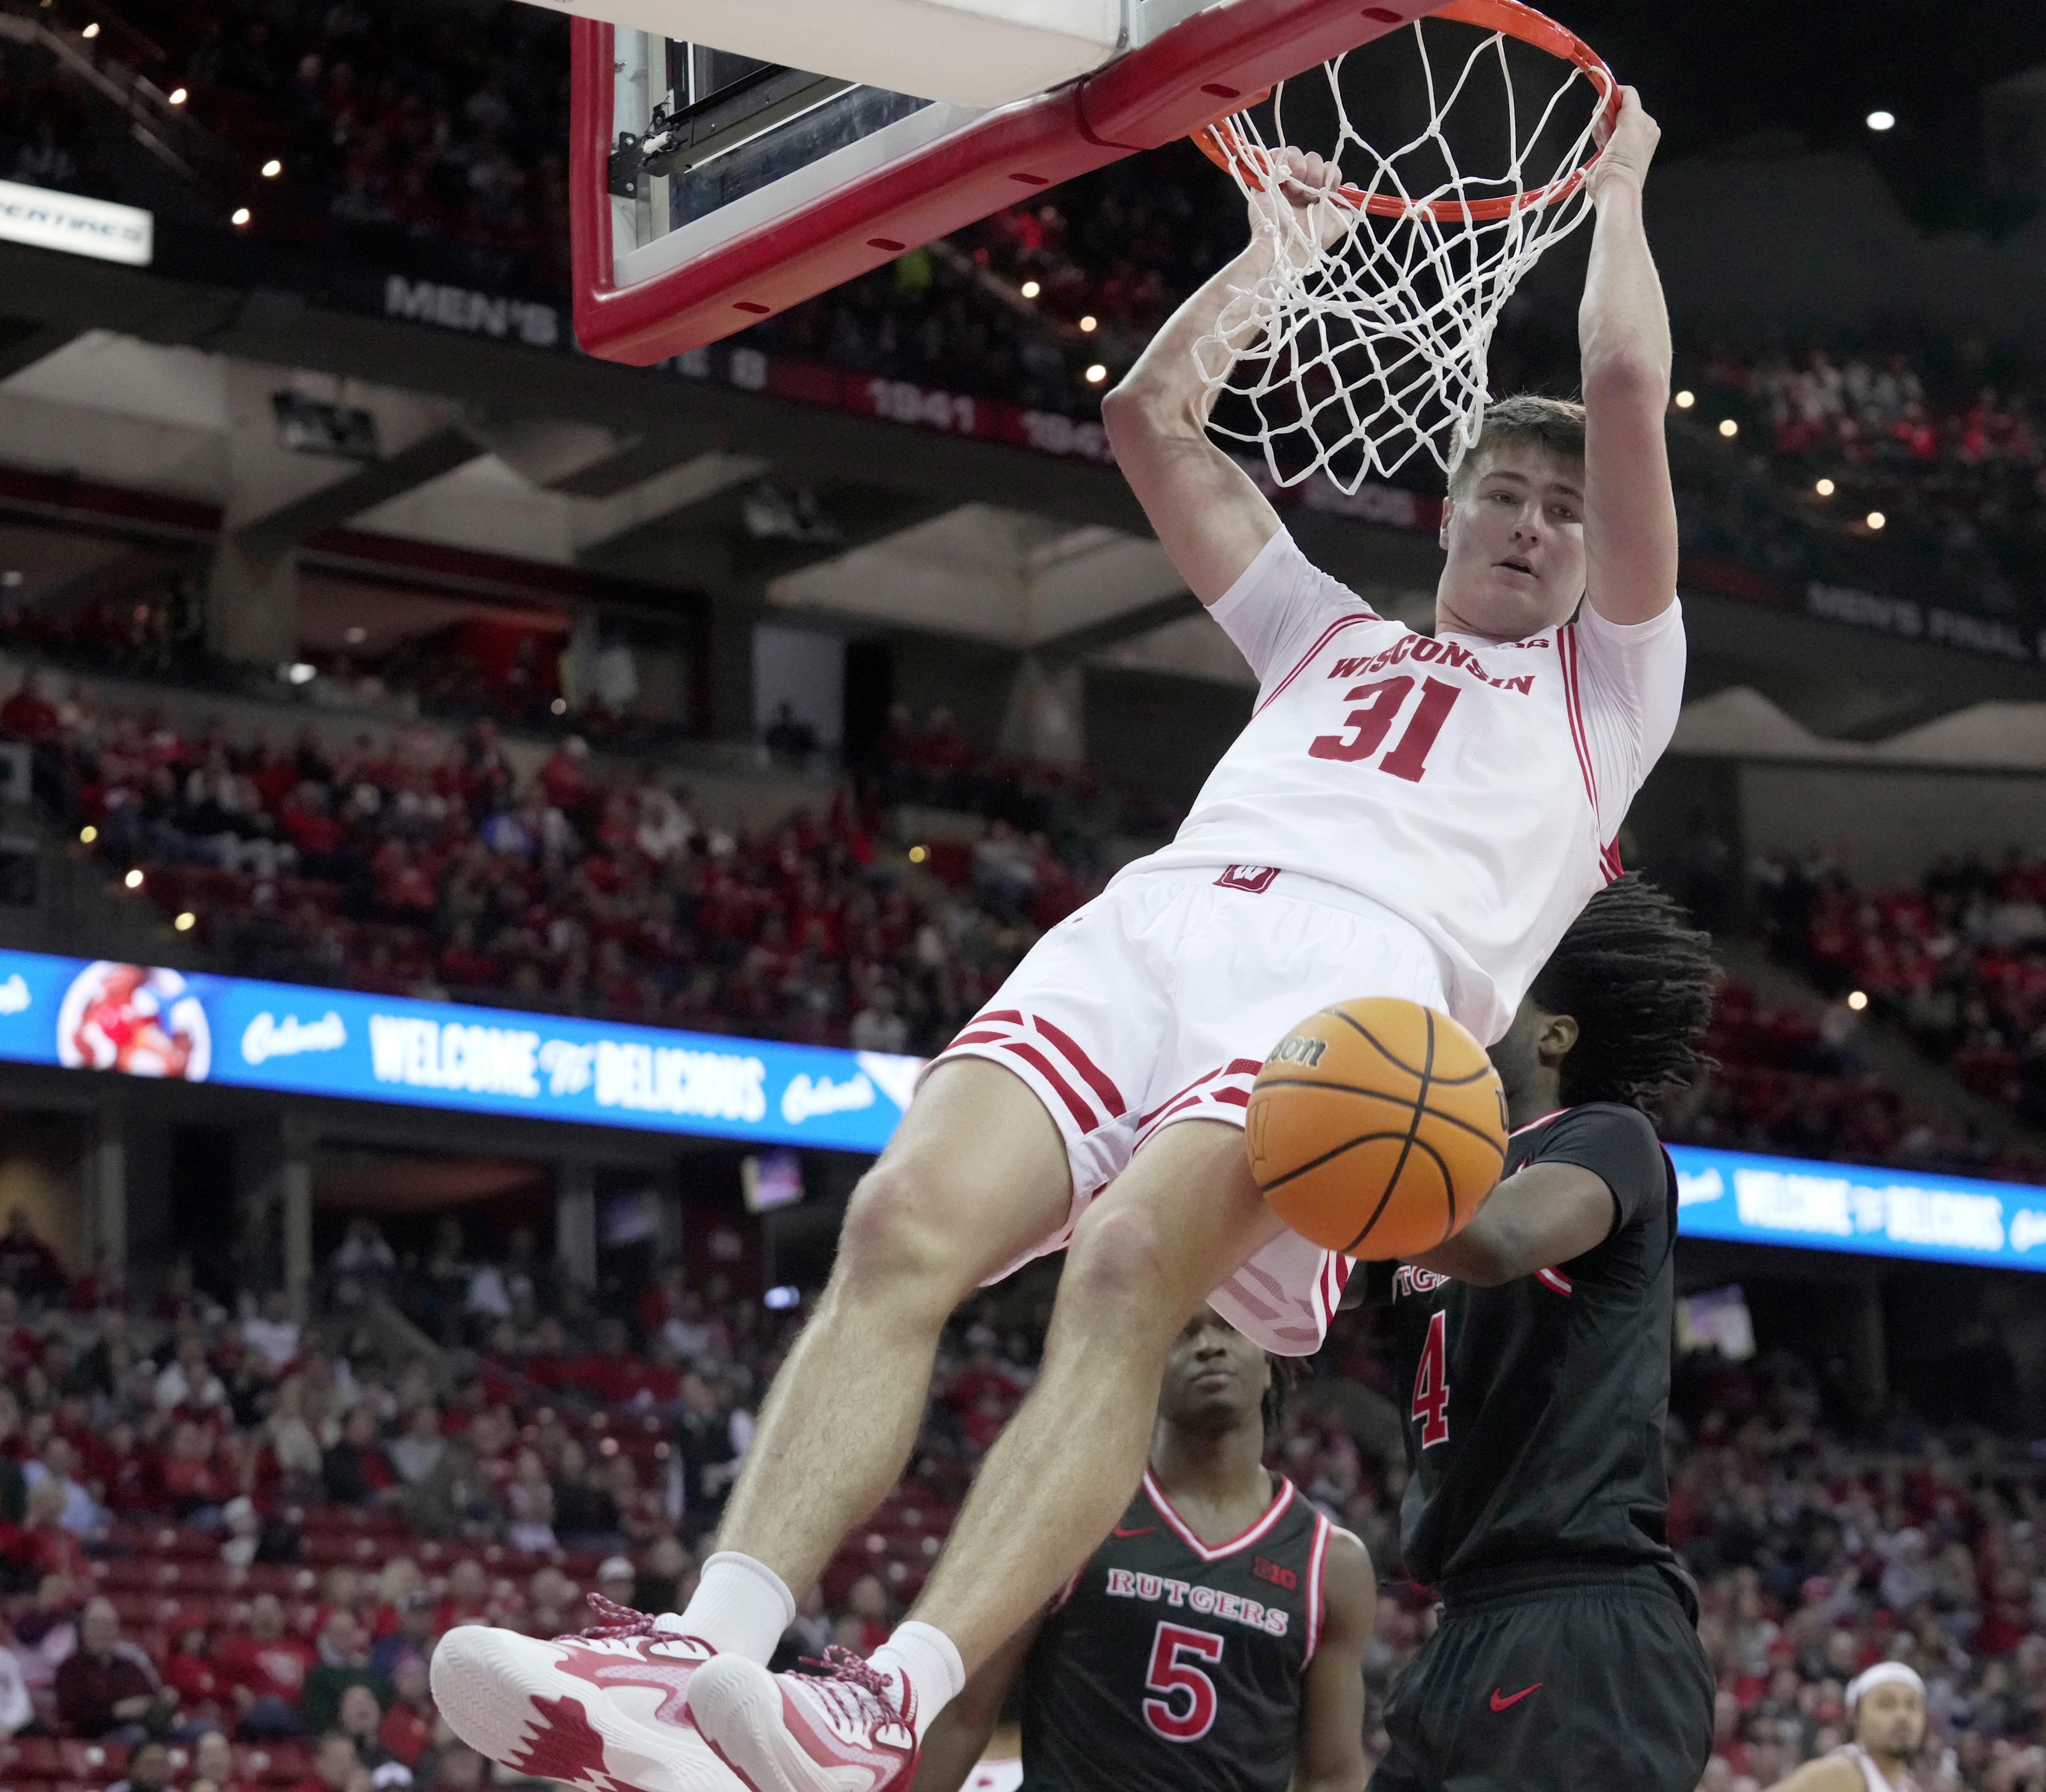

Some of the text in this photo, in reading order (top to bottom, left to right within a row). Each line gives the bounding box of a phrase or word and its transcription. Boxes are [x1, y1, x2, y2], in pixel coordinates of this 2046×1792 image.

[1327, 634, 1536, 696] WISCONSIN
[1308, 675, 1462, 783] 31
[369, 1013, 541, 1098] WELCOME
[594, 1039, 767, 1123] DELICIOUS
[1412, 1309, 1449, 1450] 4
[1106, 1568, 1289, 1637] RUTGERS
[1142, 1620, 1224, 1743] 5
